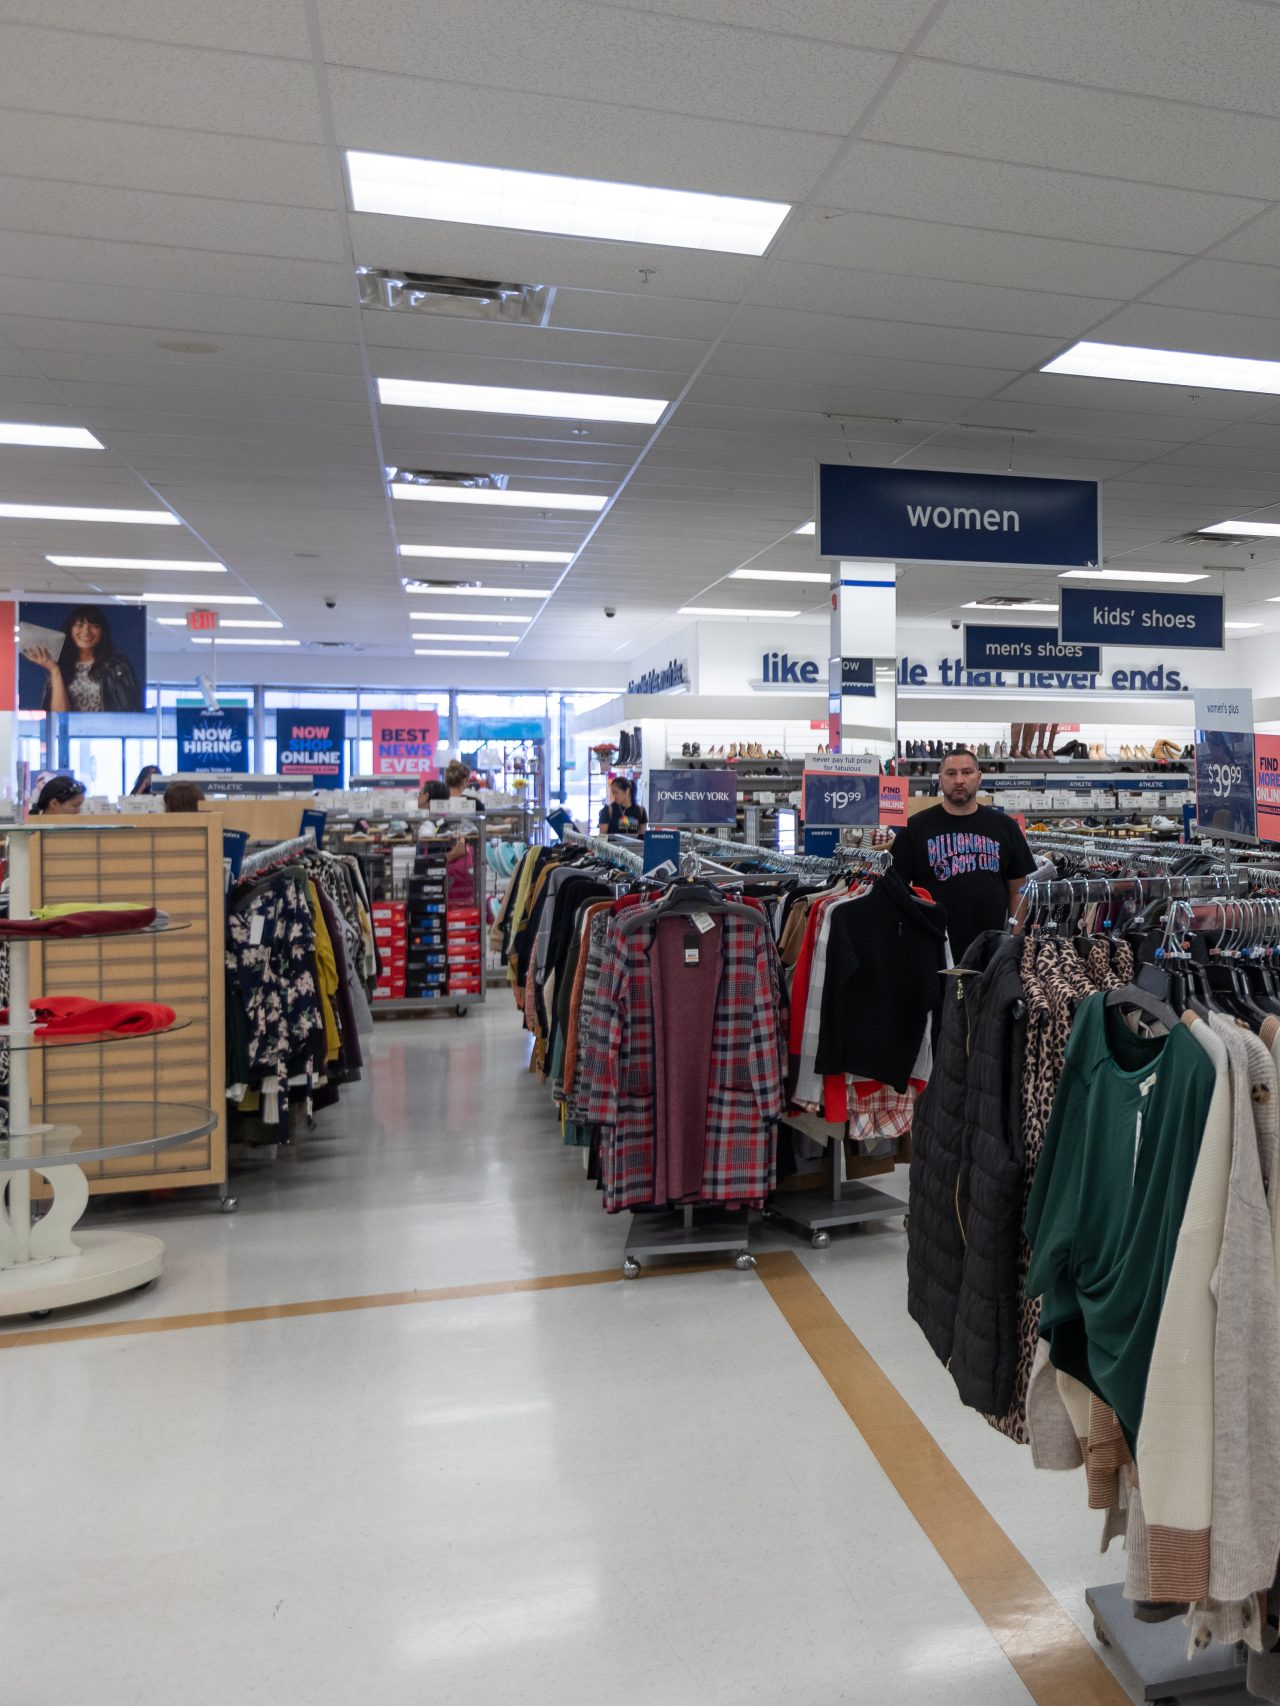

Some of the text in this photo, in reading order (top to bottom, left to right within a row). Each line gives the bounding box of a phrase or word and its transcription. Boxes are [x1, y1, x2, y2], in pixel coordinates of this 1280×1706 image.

[907, 502, 1020, 533] women
[1093, 606, 1196, 629] kids' shoes
[986, 641, 1083, 658] men's shoes
[763, 652, 819, 683] like
[1111, 664, 1189, 692] ends.
[1207, 703, 1240, 716] women's plus
[193, 728, 233, 741] NOW
[292, 726, 330, 739] NOW
[381, 728, 430, 742] BEST
[183, 741, 243, 754] HIRING
[289, 739, 333, 751] SHOP
[378, 743, 433, 757] NEWS
[280, 751, 341, 765] ONLINE
[856, 757, 872, 765] price
[1260, 757, 1279, 772] FIND
[380, 758, 431, 773] EVER
[1258, 772, 1280, 787] MORE
[207, 783, 244, 791] ATHLETIC
[657, 791, 729, 802] JONES NEW YORK
[927, 832, 1001, 867] BILLIONAIRE
[951, 853, 1000, 877] BOYS CLUB
